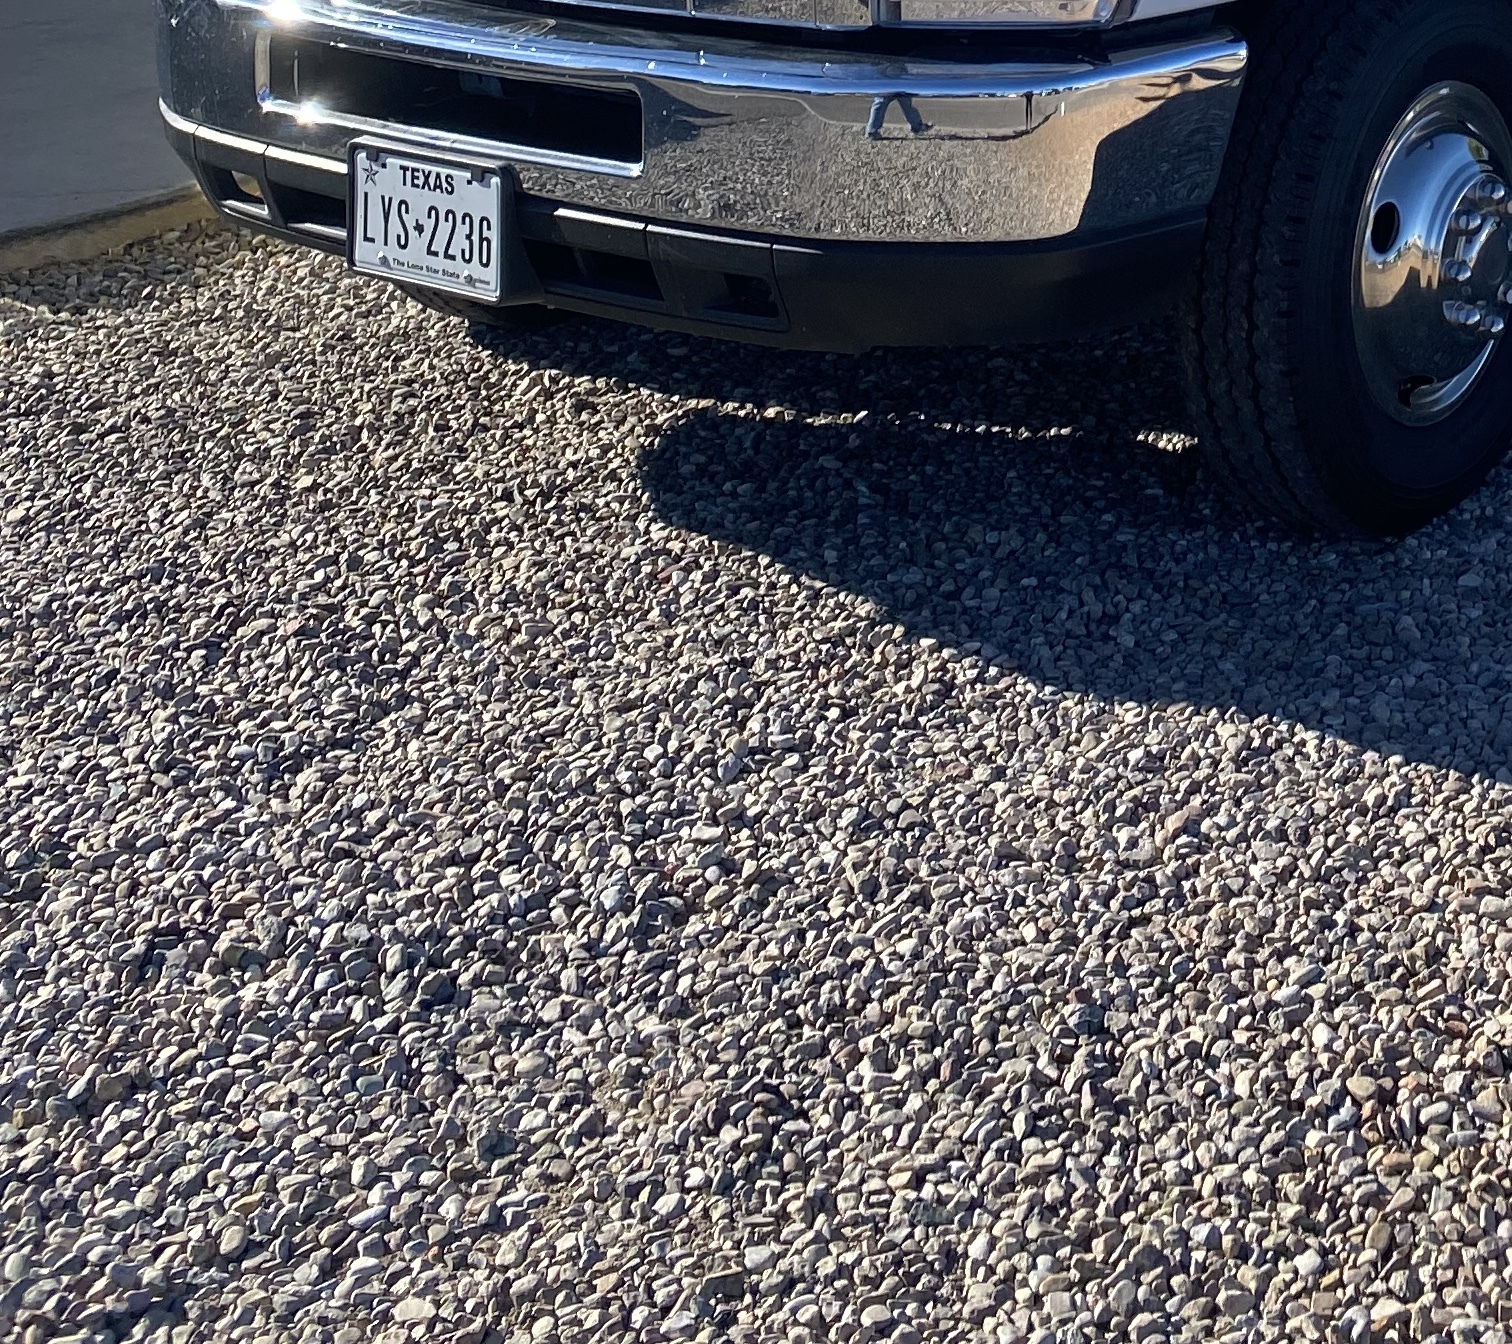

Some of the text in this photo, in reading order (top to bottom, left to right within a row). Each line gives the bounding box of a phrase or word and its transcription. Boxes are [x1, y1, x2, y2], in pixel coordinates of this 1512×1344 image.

[399, 164, 455, 196] TEXAS
[393, 258, 406, 267] The
[425, 265, 440, 275] Star
[441, 268, 460, 279] State
